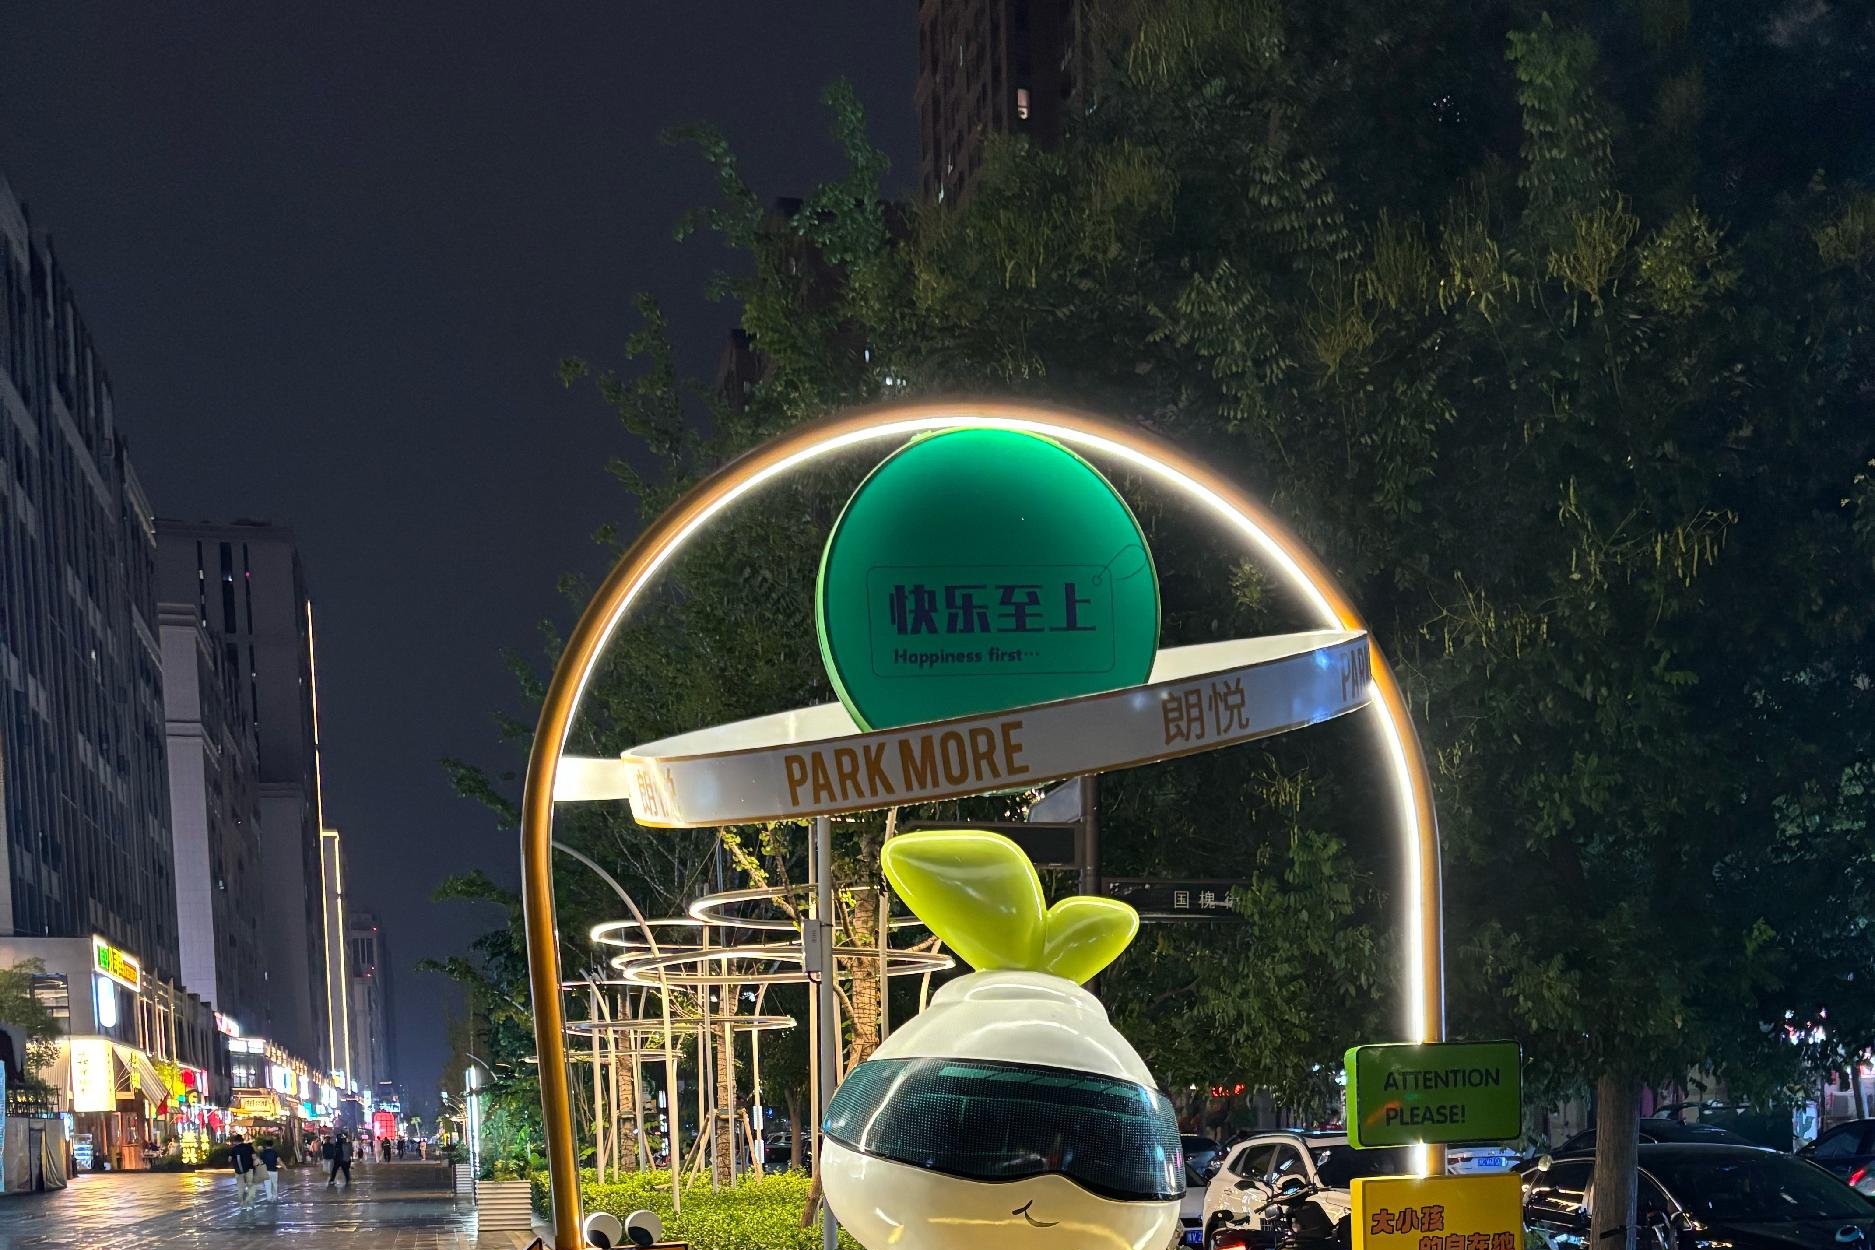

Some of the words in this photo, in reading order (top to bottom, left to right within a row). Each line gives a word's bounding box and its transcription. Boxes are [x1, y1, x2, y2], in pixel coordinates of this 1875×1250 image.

[889, 582, 1097, 636] 快乐至上
[894, 647, 983, 669] Happiness
[1161, 677, 1250, 745] 朗悦
[784, 741, 896, 808] PARK
[898, 720, 1030, 793] MORE
[1383, 1067, 1500, 1092] ATTENTION
[1385, 1104, 1466, 1128] PLEASE!
[1370, 1204, 1444, 1236] 大小孩
